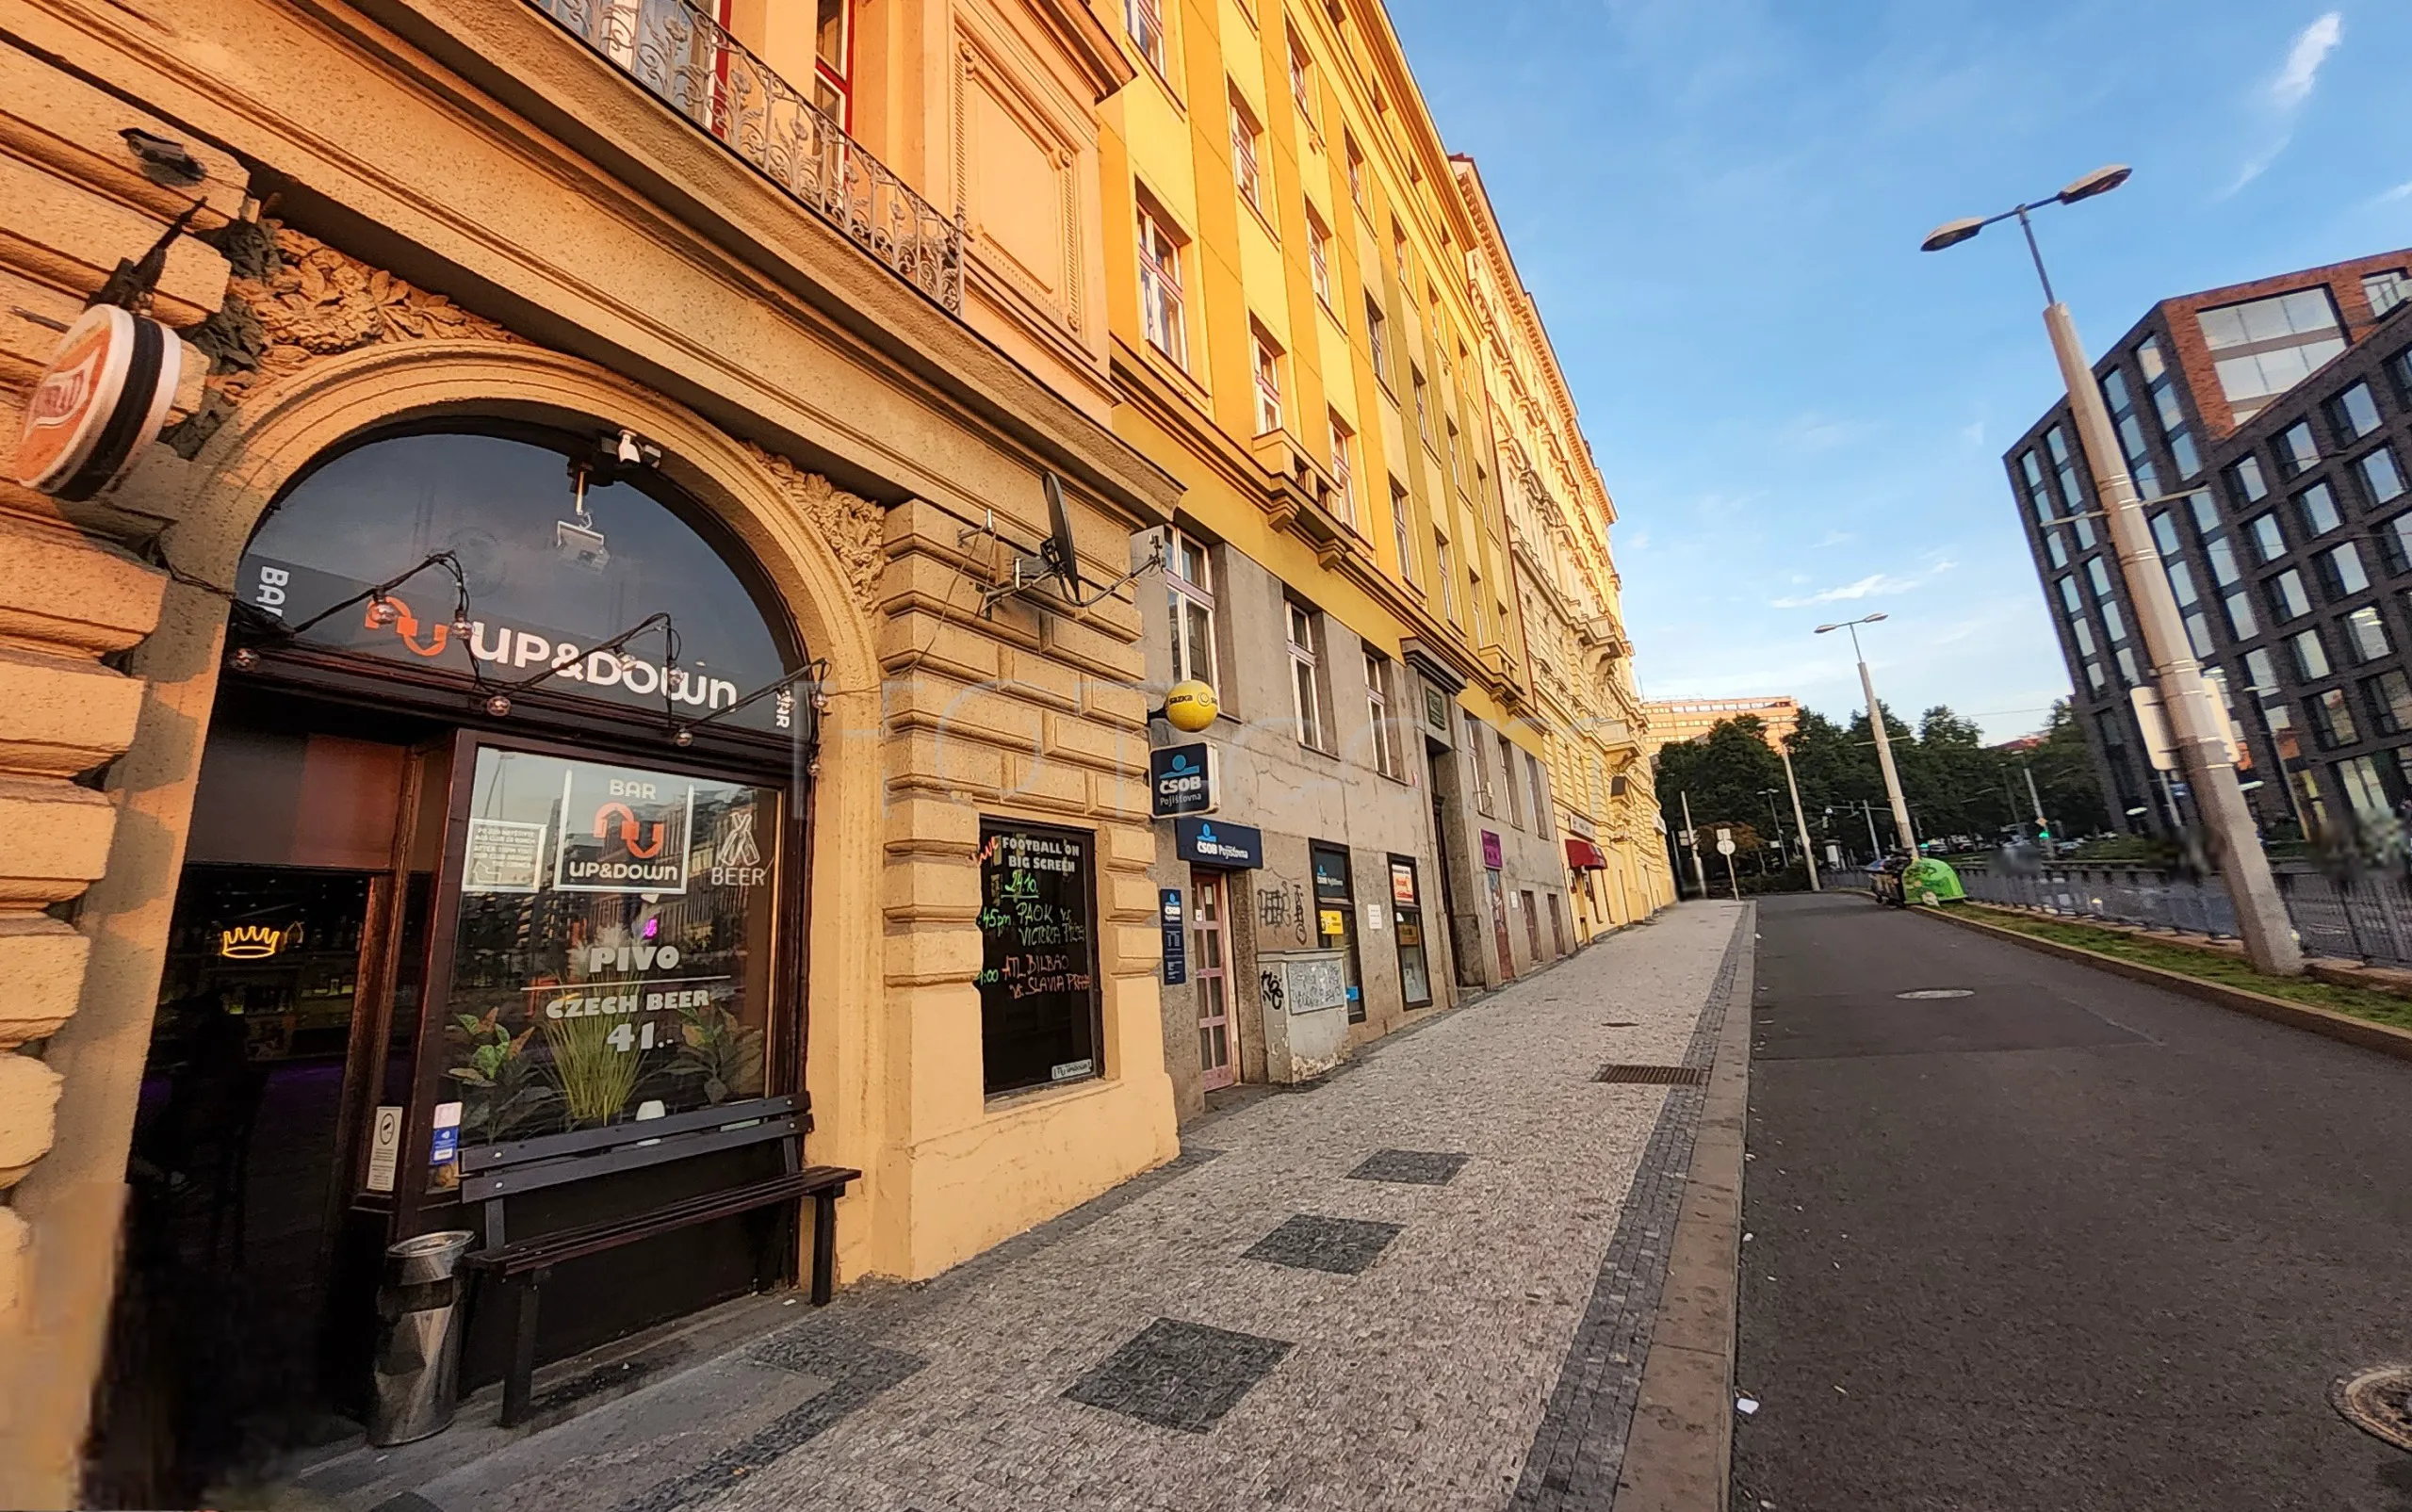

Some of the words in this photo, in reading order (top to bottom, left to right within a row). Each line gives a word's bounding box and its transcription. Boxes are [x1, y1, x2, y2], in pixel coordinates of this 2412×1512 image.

[610, 779, 657, 800] BAR
[1159, 775, 1202, 795] ČSOB
[1002, 837, 1063, 854] FOOTBALL
[1065, 844, 1080, 856] ON
[1007, 855, 1031, 869] BIG
[1033, 856, 1075, 872] SCREEN
[711, 867, 765, 886] BEER
[589, 945, 680, 973] PIVO
[546, 994, 638, 1019] CZECH
[645, 989, 709, 1011] BEER
